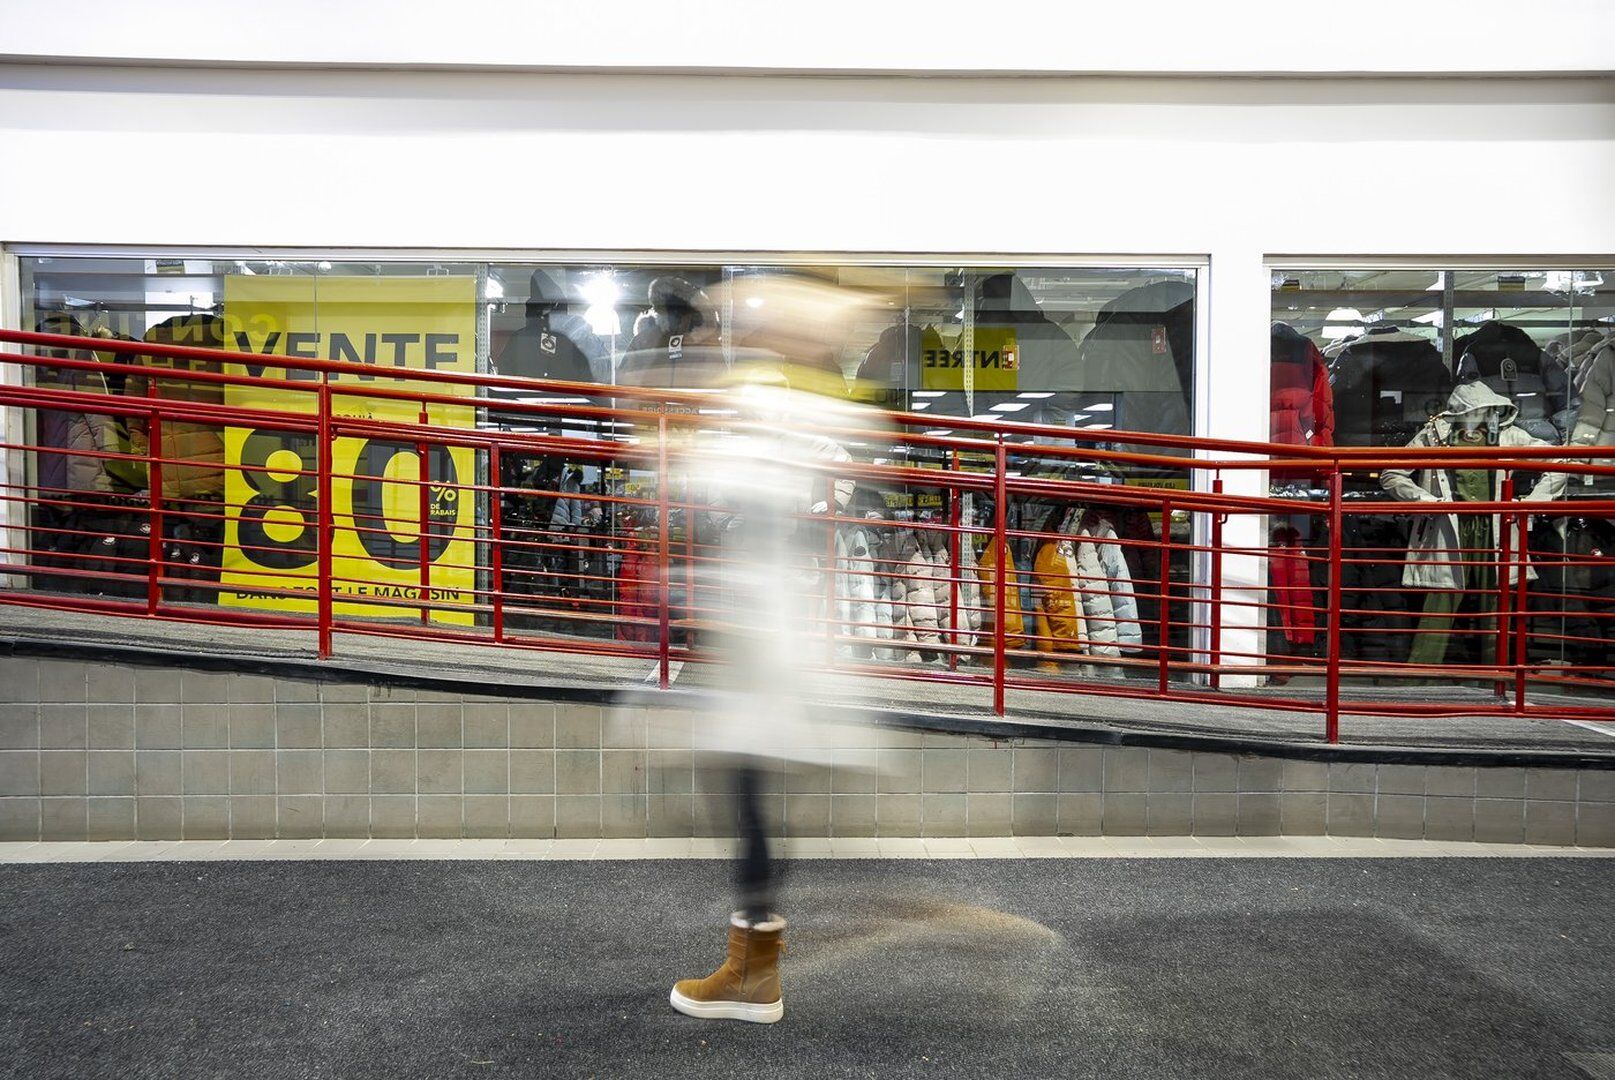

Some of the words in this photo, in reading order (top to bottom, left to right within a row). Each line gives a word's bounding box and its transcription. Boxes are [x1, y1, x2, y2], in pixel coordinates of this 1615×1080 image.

[233, 332, 459, 382] VENTE
[237, 427, 459, 570] 80
[374, 586, 460, 600] MAGSIN
